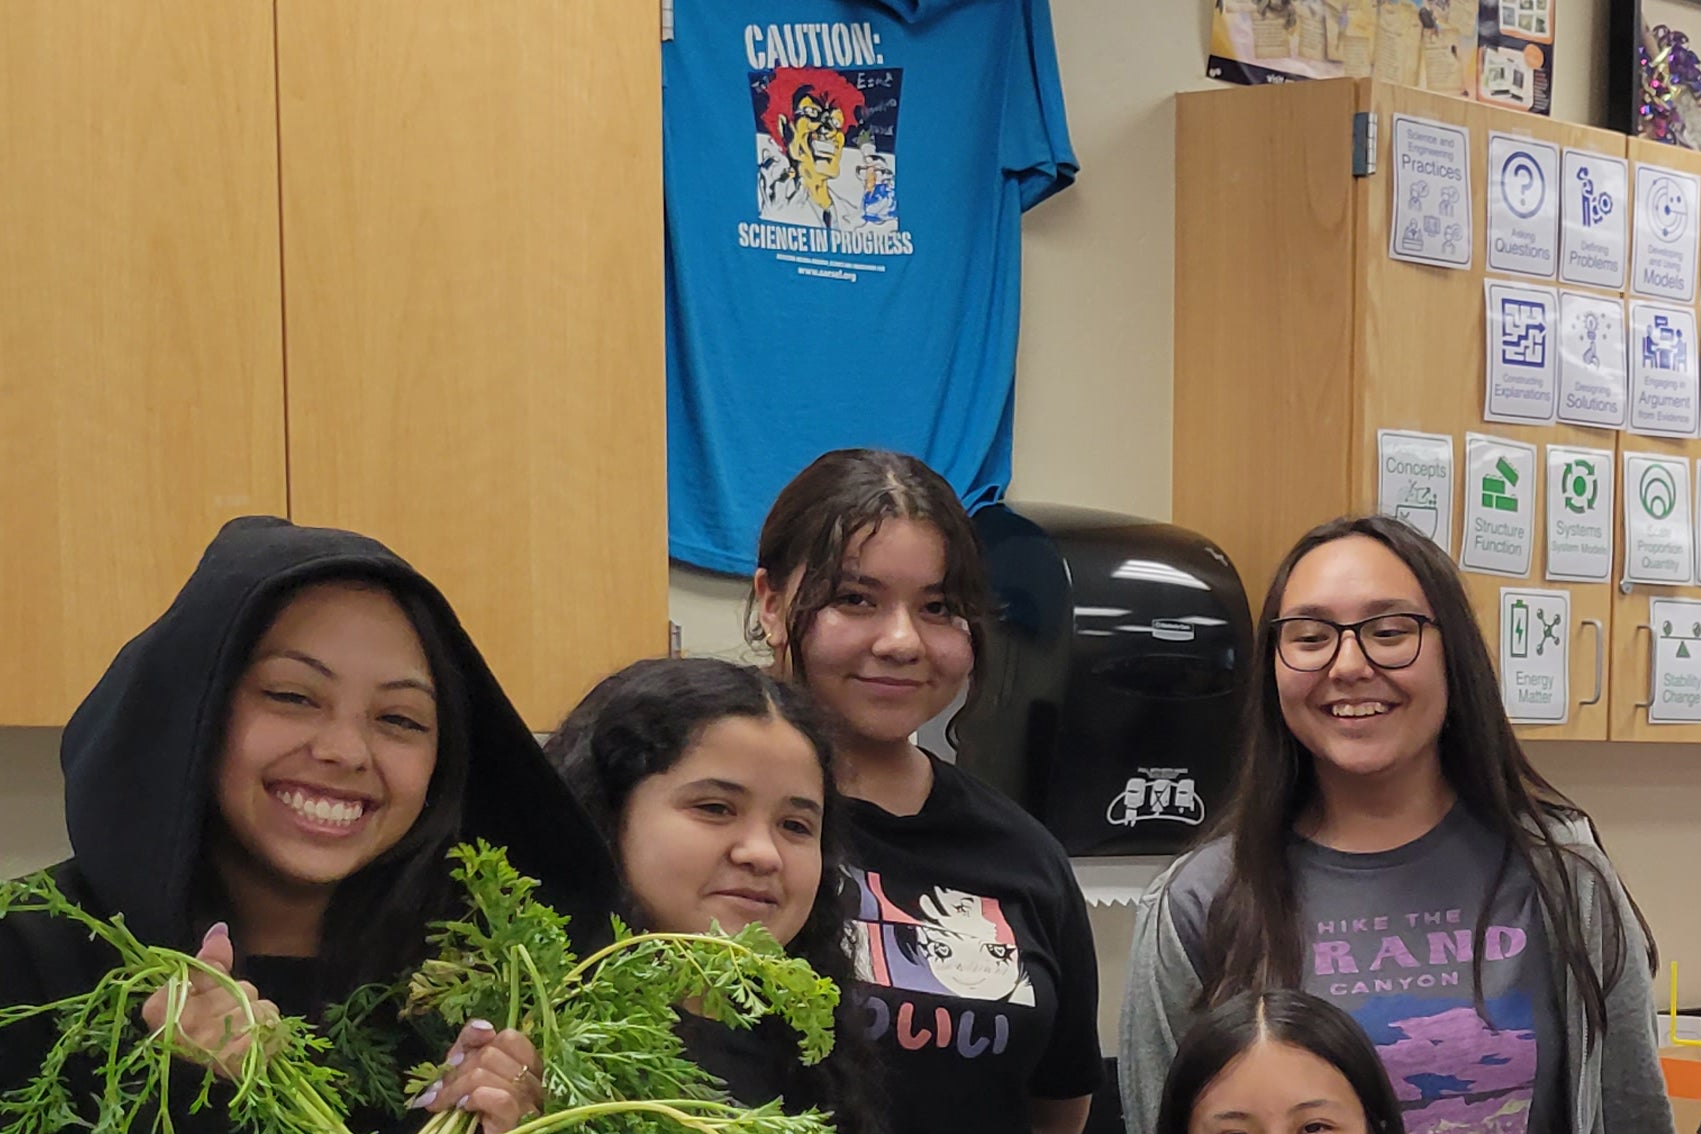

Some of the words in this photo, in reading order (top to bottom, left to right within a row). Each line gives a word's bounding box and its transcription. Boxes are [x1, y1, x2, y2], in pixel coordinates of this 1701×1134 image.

[745, 22, 884, 69] CAUTION:
[1402, 153, 1462, 181] Practices
[738, 222, 808, 251] SCIENCE
[810, 228, 828, 253] IN
[831, 230, 913, 255] PROGRESS
[1495, 238, 1550, 260] Questions
[1570, 250, 1618, 273] Problems
[1643, 268, 1685, 290] Models
[1494, 383, 1551, 402] Explanations
[1566, 393, 1618, 413] Solutions
[1639, 391, 1691, 409] Argument
[1386, 456, 1446, 480] Concepts
[1474, 517, 1525, 539] Structure
[1556, 520, 1602, 539] Systems
[1474, 535, 1522, 557] Function
[1516, 671, 1554, 690] Energy
[1663, 672, 1701, 689] Stability
[1518, 689, 1552, 704] Matter
[1662, 689, 1701, 707] Change
[1317, 916, 1389, 935] HIKE
[1406, 909, 1462, 928] THE
[1313, 925, 1528, 975] RAND
[1329, 971, 1459, 996] CANYON
